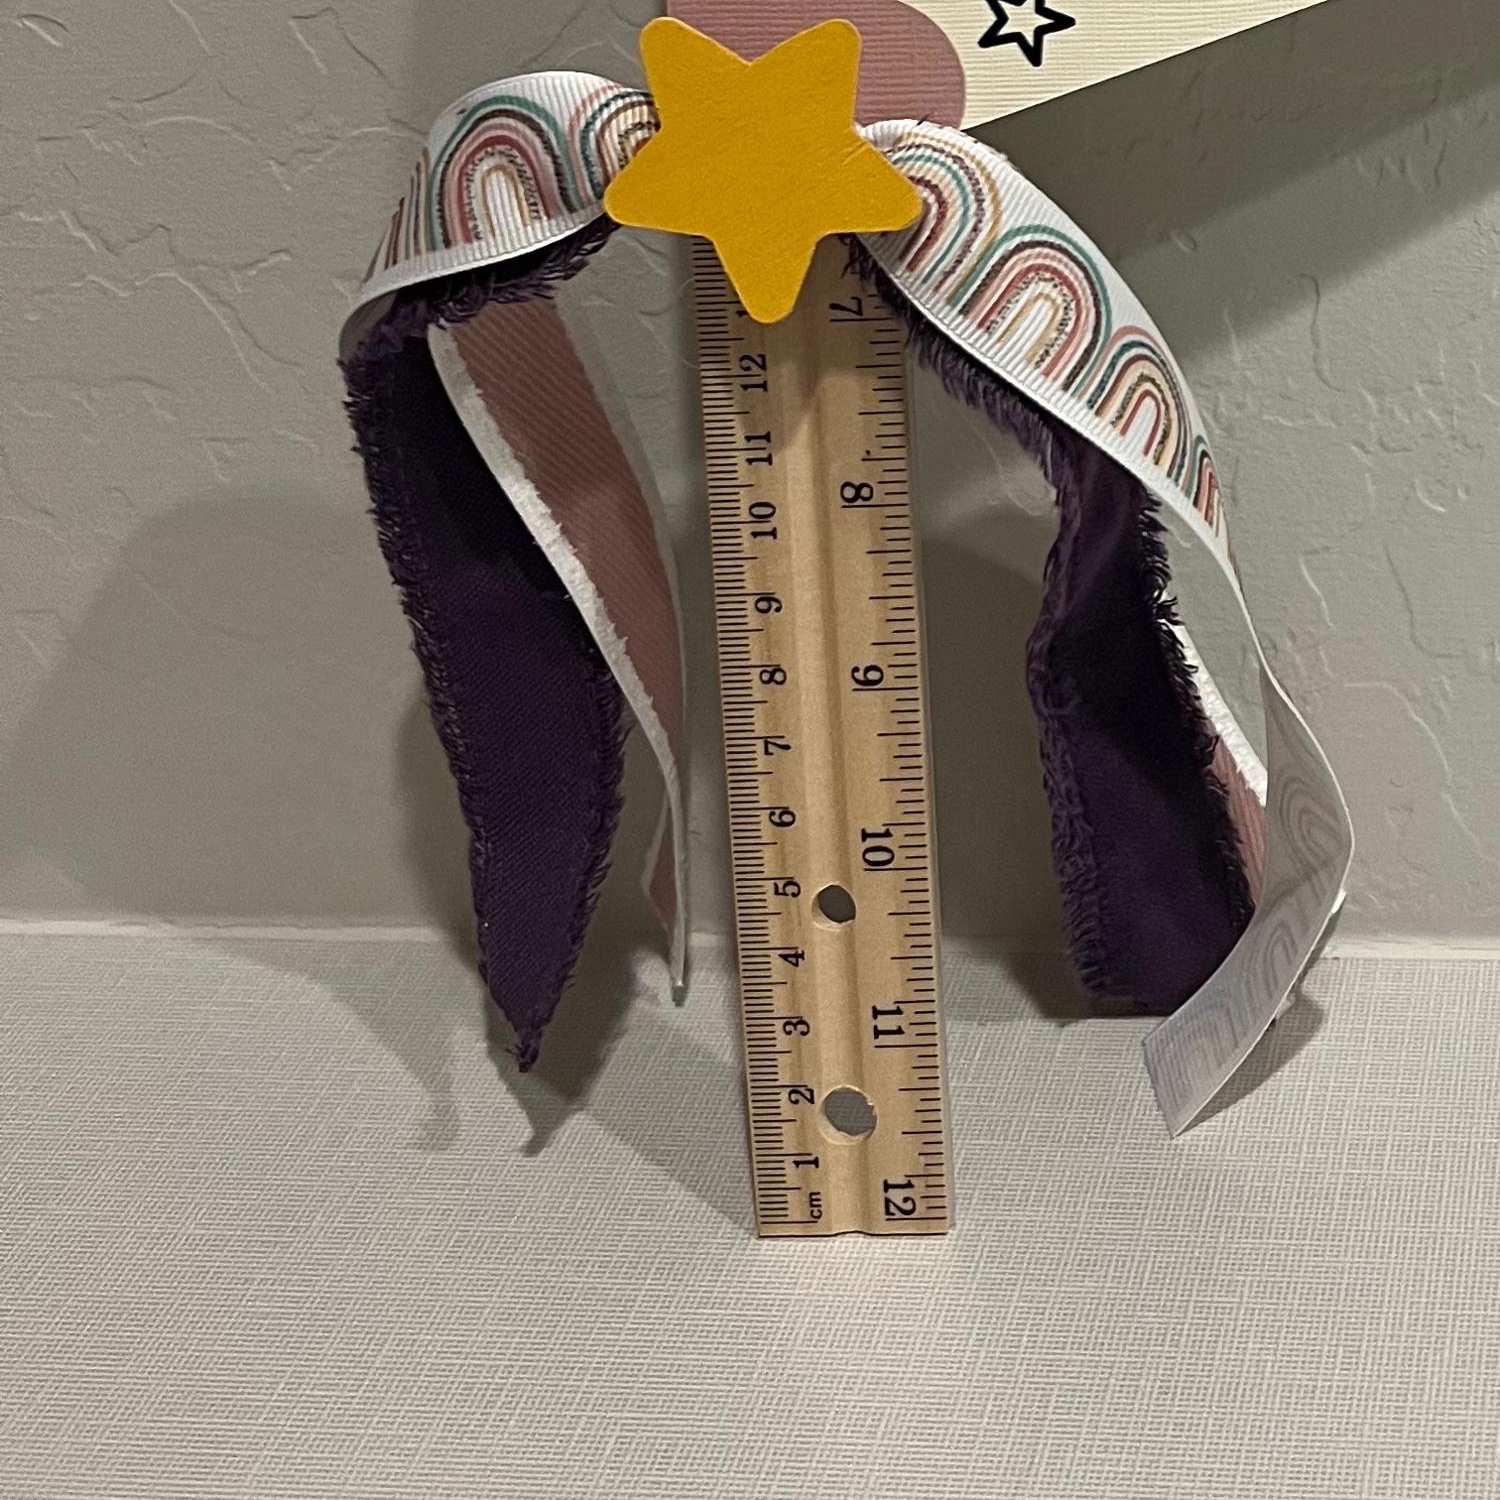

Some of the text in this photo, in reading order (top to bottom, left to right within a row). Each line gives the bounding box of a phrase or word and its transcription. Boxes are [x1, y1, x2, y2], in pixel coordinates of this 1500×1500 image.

[830, 296, 863, 316] 7
[740, 353, 768, 392] 12
[745, 431, 772, 466] 11
[840, 481, 874, 504] 8
[749, 501, 777, 540] 10
[755, 596, 782, 614] 9
[760, 667, 787, 686] 8
[851, 664, 884, 687] 9
[764, 739, 792, 756] 7
[769, 809, 796, 828] 6
[861, 827, 895, 867] 10
[774, 880, 801, 898] 5
[779, 950, 804, 968] 4
[783, 1019, 811, 1037] 3
[872, 1005, 906, 1040] 11
[789, 1088, 815, 1105] 2
[793, 1156, 819, 1169] 1
[807, 1191, 823, 1219] cm
[883, 1178, 916, 1217] 12
